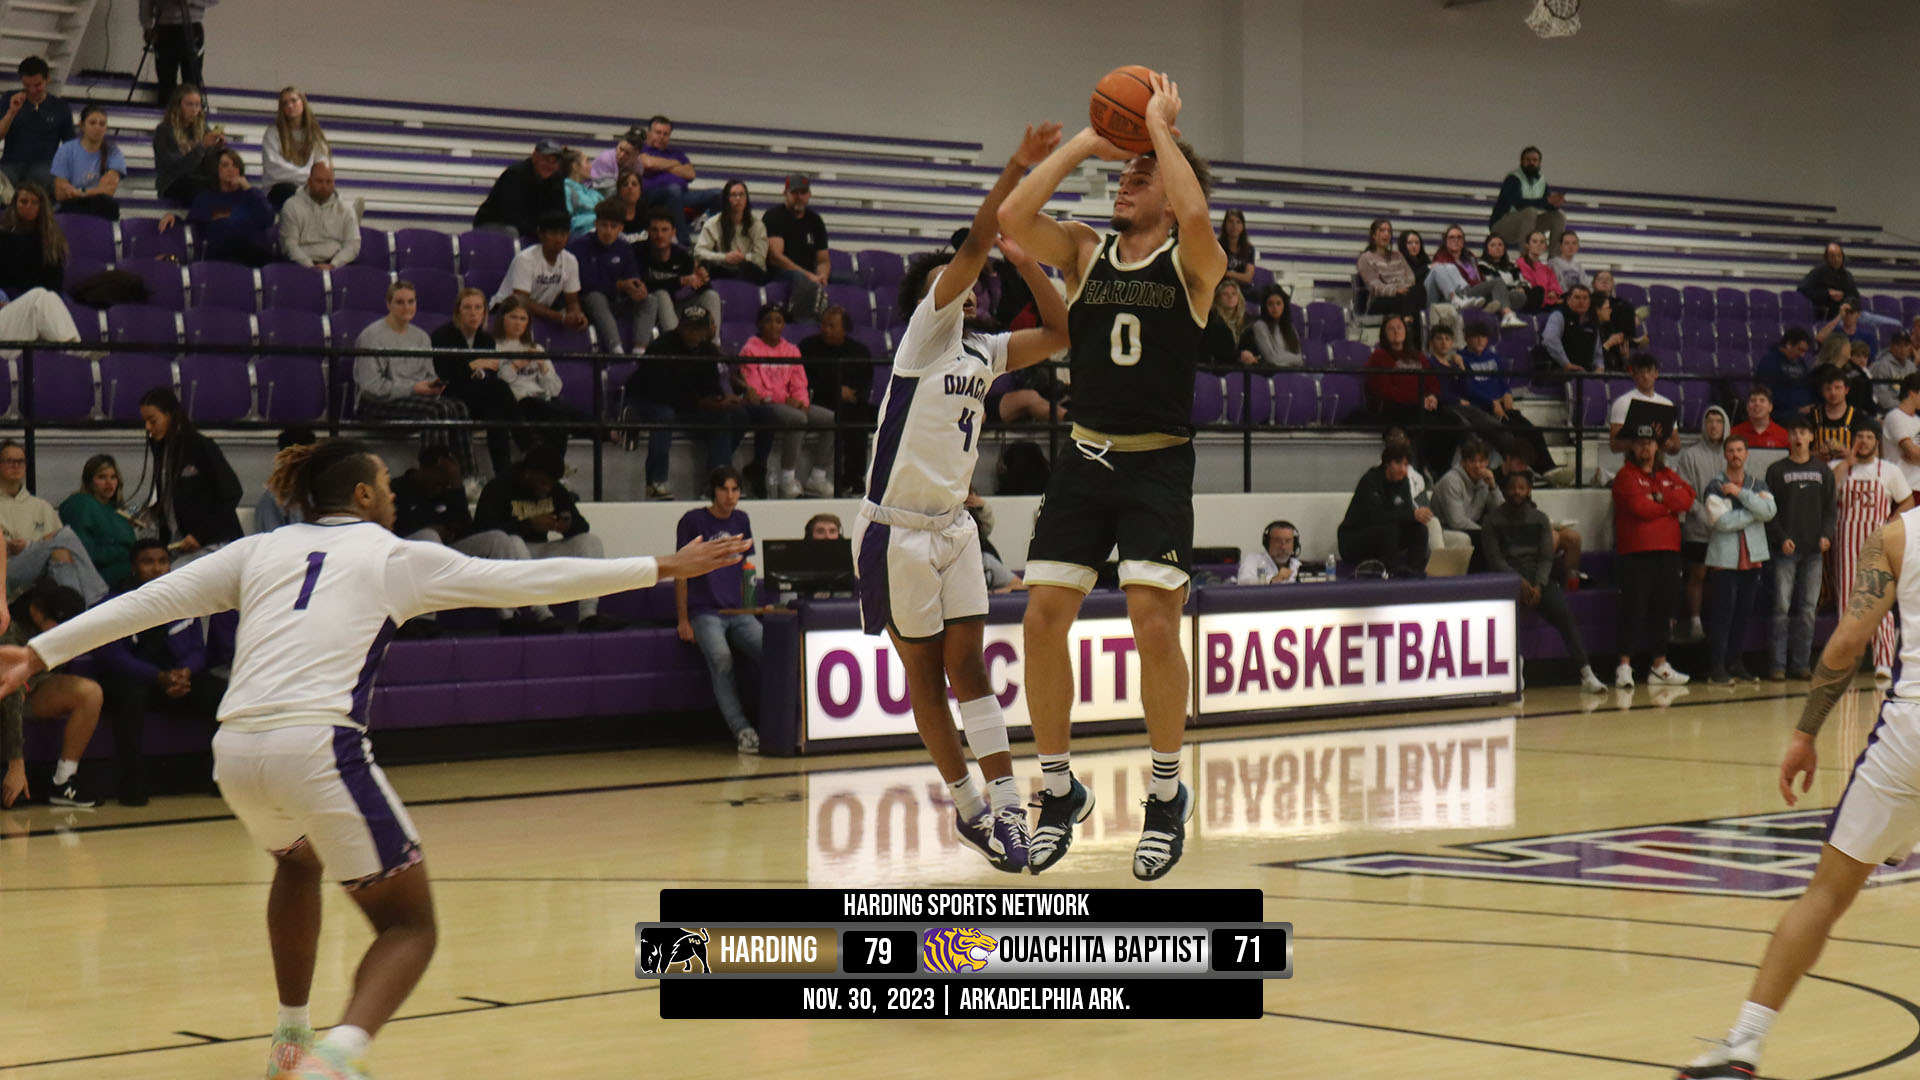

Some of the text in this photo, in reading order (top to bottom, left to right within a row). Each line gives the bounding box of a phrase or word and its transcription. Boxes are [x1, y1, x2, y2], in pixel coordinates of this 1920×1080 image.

[1084, 279, 1176, 309] HARDING
[1110, 312, 1142, 367] 0
[958, 407, 976, 453] 4
[294, 551, 327, 611] 1
[816, 617, 1509, 719] OUCIT BASKETBALL
